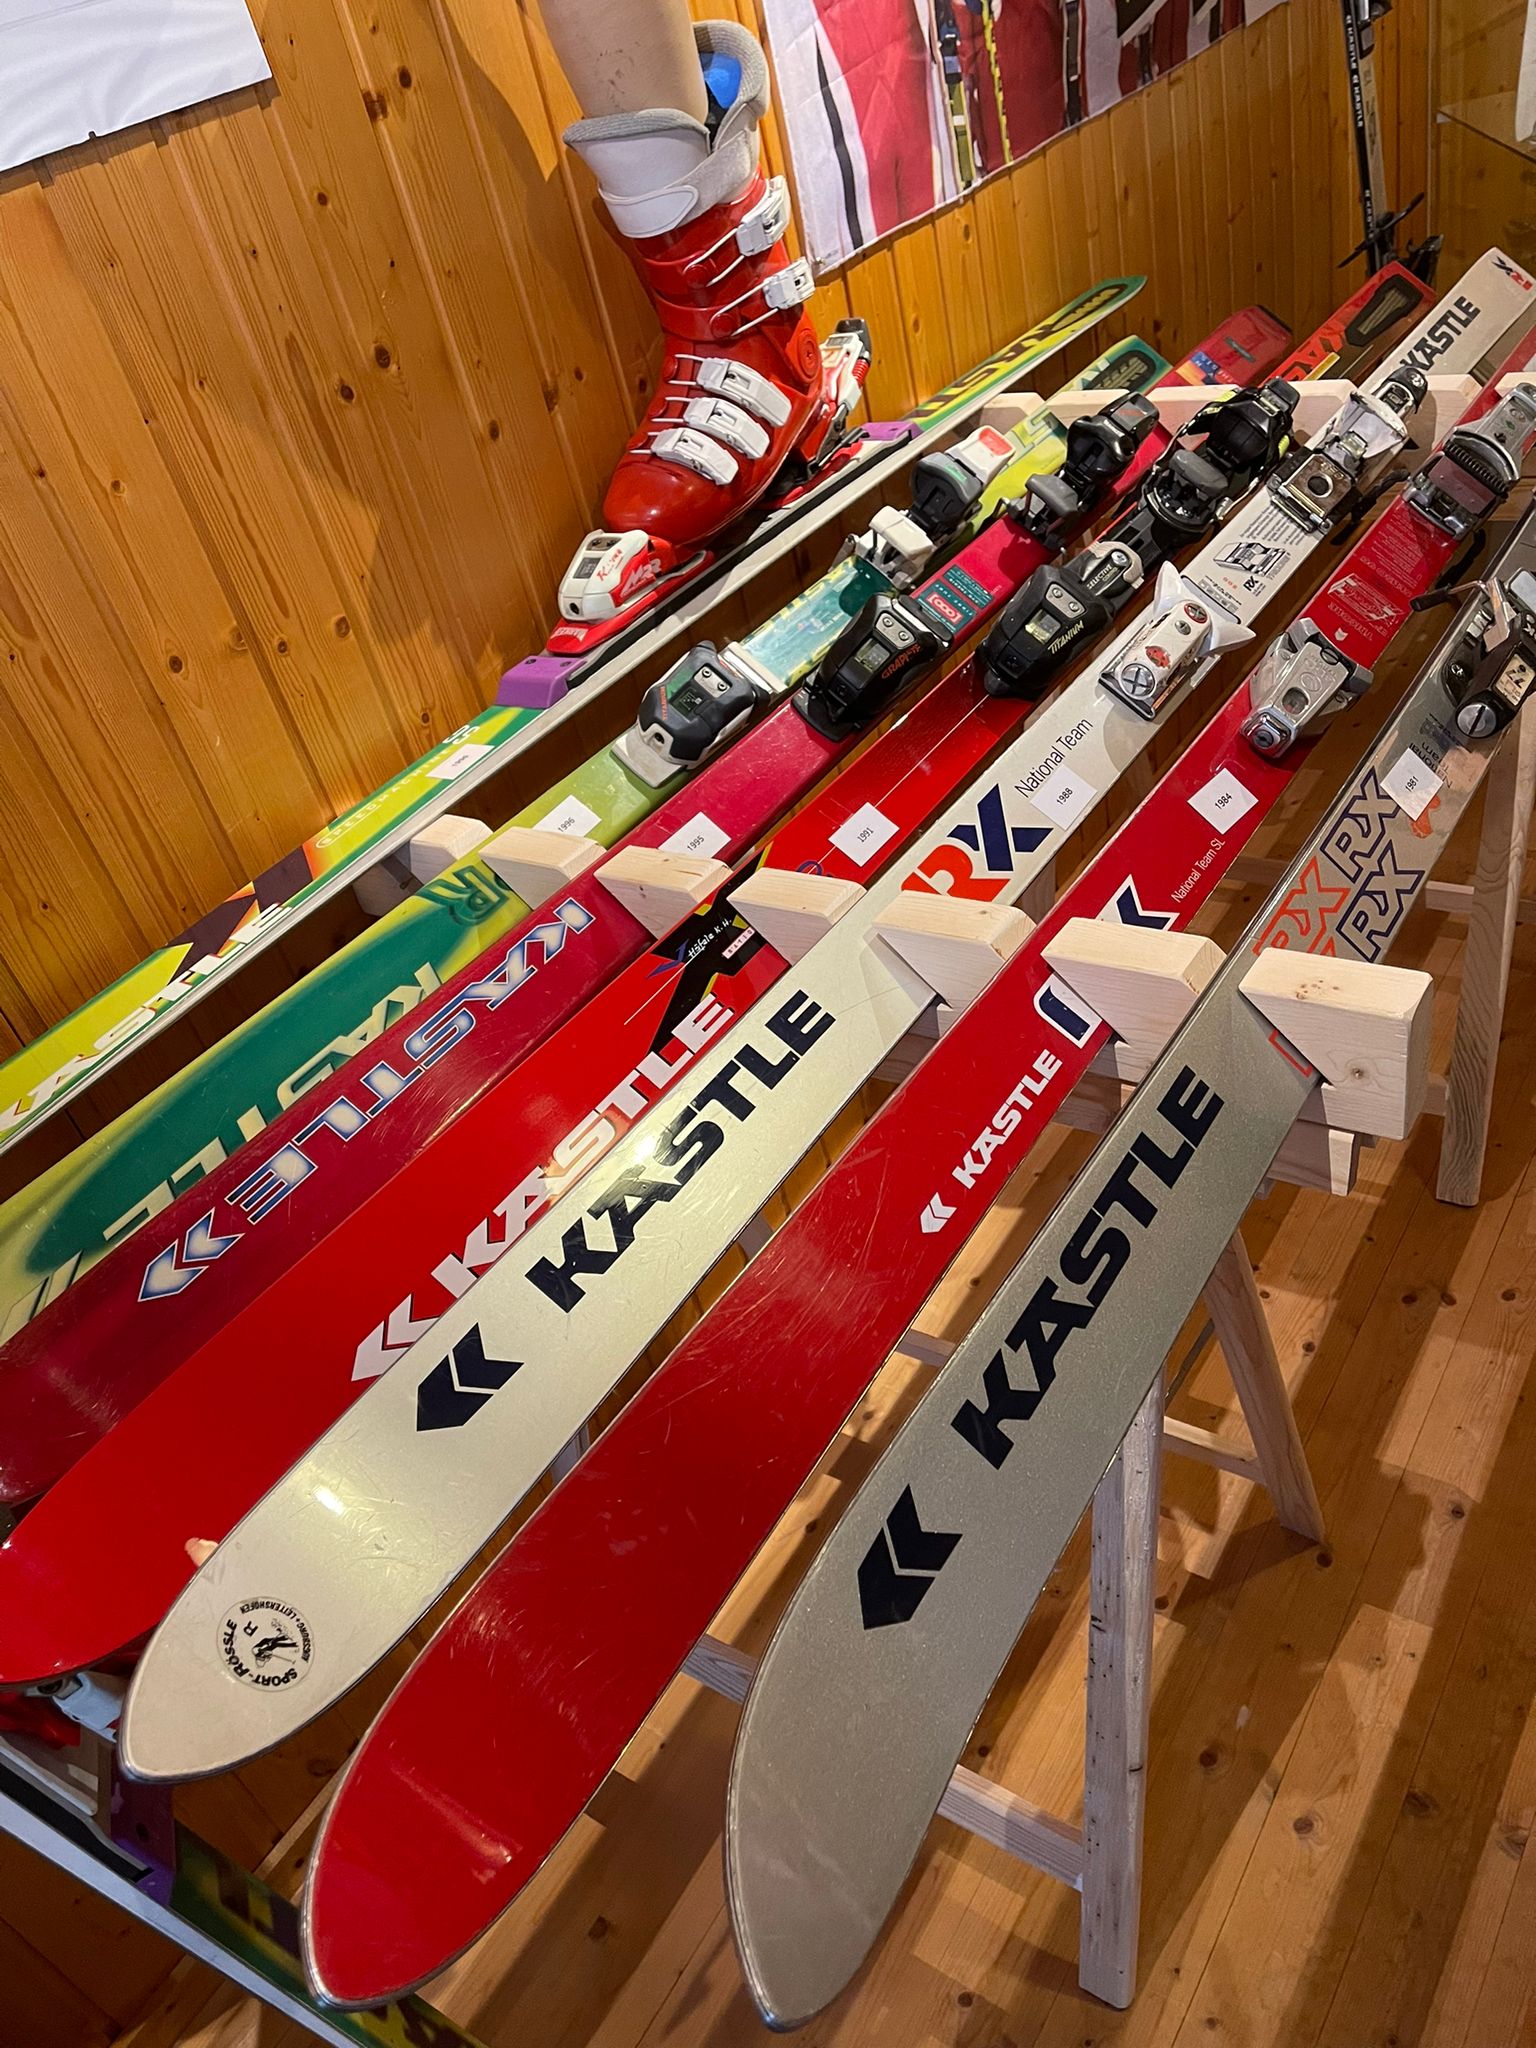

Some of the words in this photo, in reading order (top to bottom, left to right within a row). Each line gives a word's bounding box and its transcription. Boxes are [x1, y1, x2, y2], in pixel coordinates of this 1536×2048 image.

[1047, 620, 1084, 655] TITANIUM
[1014, 743, 1059, 798] National
[1054, 718, 1094, 766] Team
[1405, 776, 1419, 792] 1981
[557, 816, 576, 833] 1996
[1056, 786, 1074, 806] 1988
[1214, 792, 1233, 809] 1984
[1320, 766, 1402, 884] RX
[687, 834, 706, 852] 1995
[856, 827, 874, 843] 1991
[860, 783, 1053, 902] RX
[1171, 868, 1201, 903] National
[1194, 849, 1217, 871] Team
[1210, 838, 1226, 851] SL
[1336, 840, 1425, 962] RX
[226, 898, 596, 1225] KASTLE
[431, 993, 735, 1291] KASTLE
[526, 989, 837, 1315] KASTLE
[952, 1048, 1063, 1191] KASTLE
[951, 1065, 1225, 1470] KASTLE
[243, 1620, 259, 1637] R
